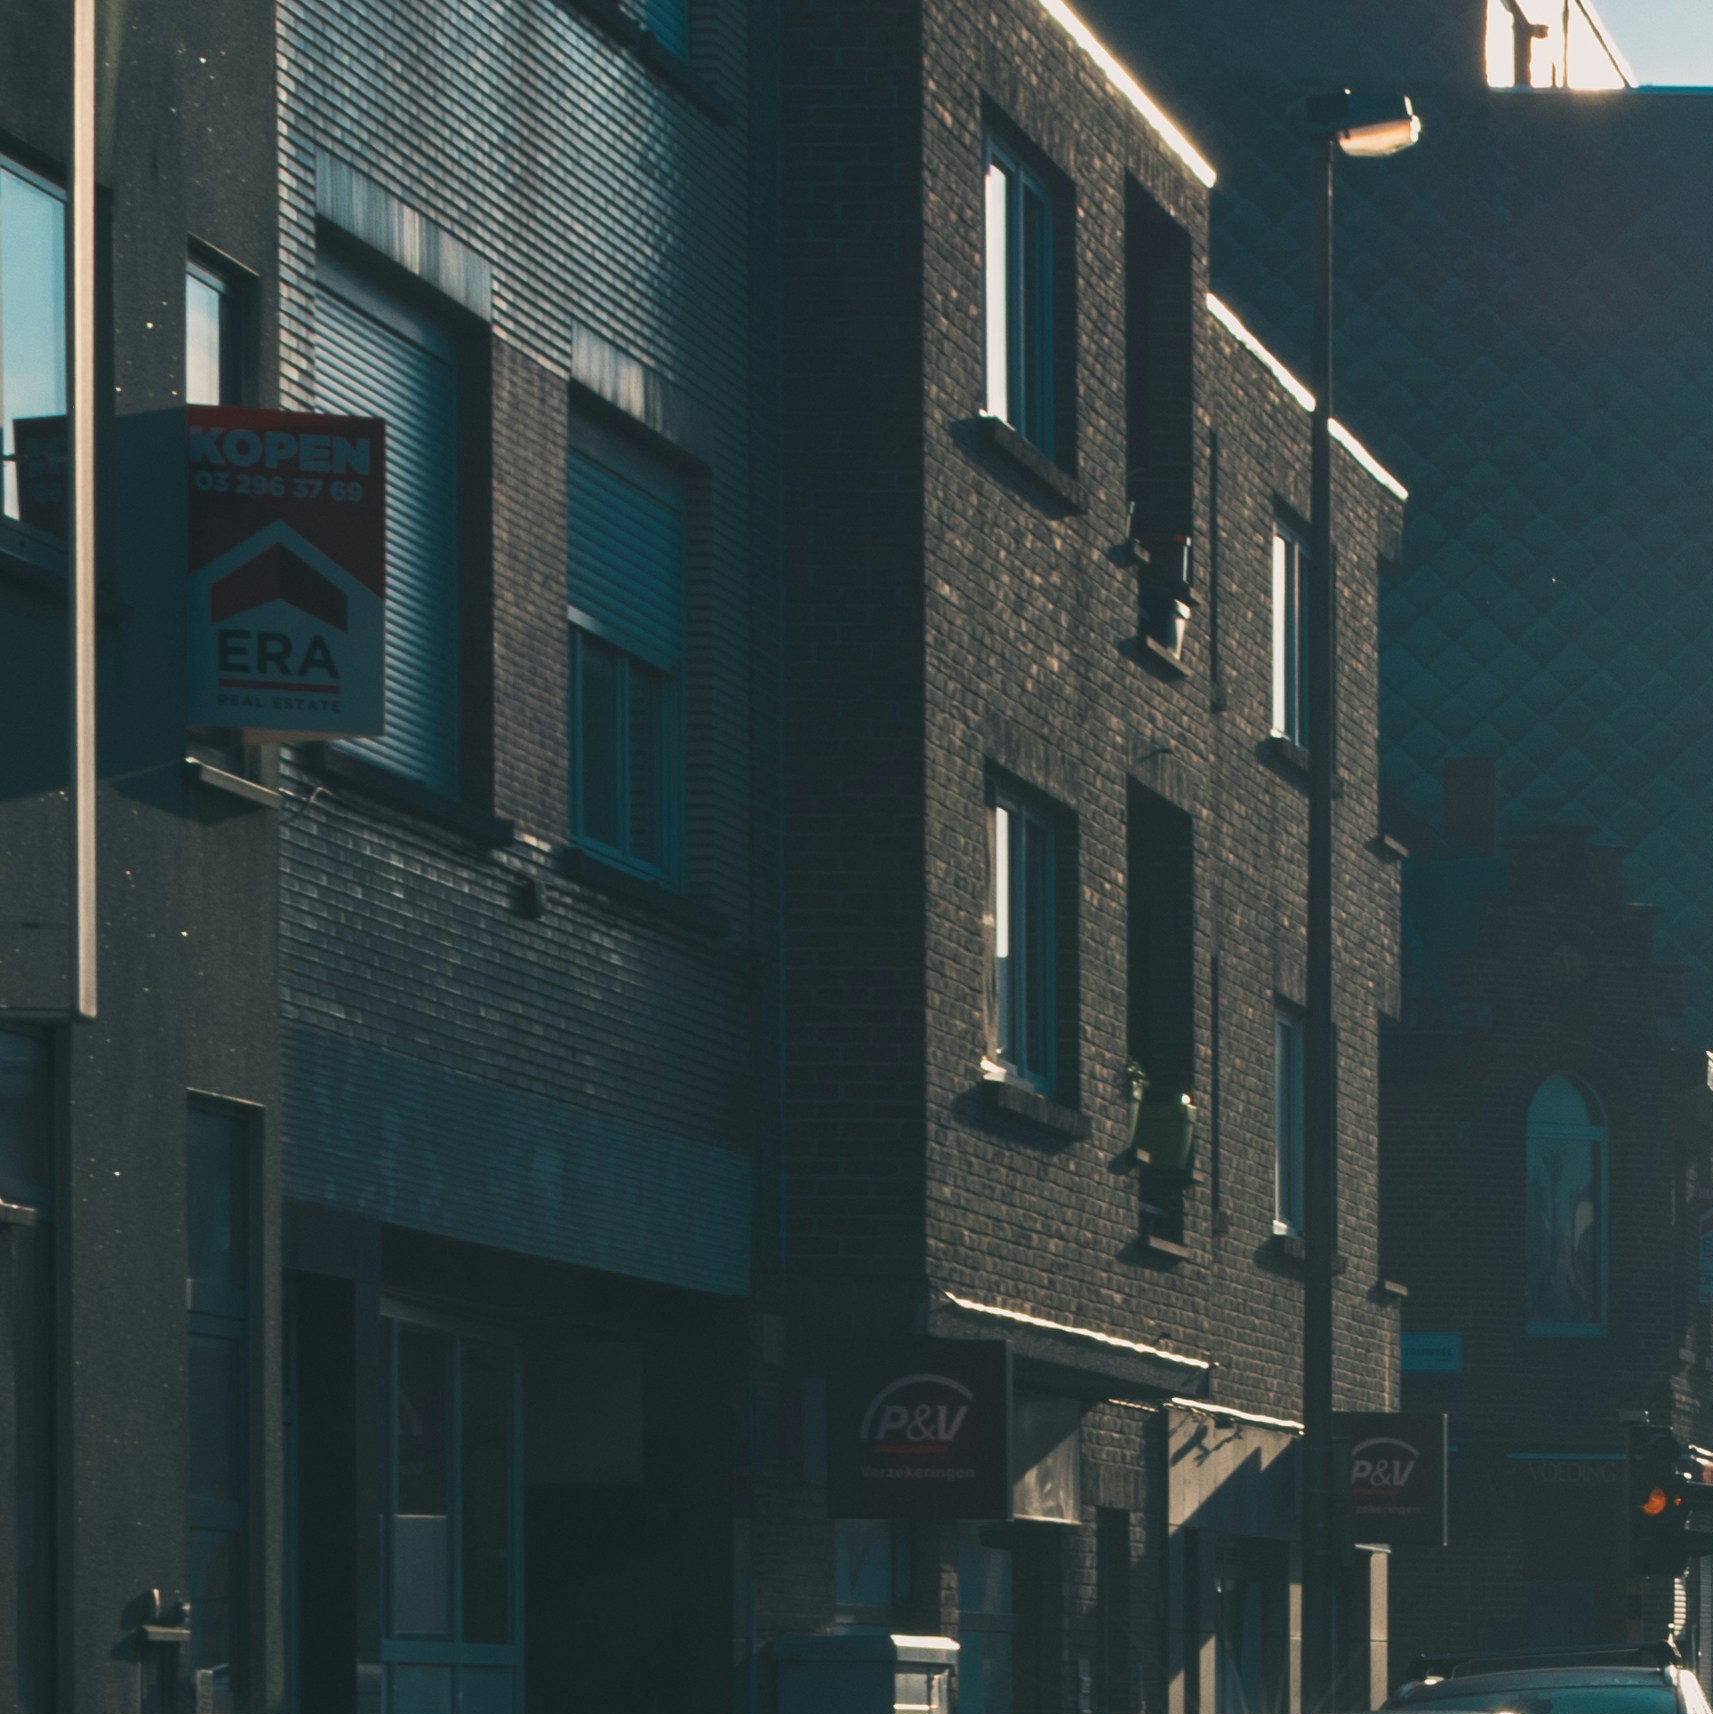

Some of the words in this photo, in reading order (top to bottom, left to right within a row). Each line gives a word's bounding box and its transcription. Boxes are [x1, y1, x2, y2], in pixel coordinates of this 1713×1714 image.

[188, 427, 371, 476] KOPEN
[196, 472, 231, 496] 03
[235, 473, 285, 498] 296
[293, 477, 326, 500] 37
[330, 480, 364, 503] 69
[218, 629, 340, 679] ERA
[217, 692, 265, 710] REAL
[272, 696, 342, 715] ESTATE
[875, 1404, 969, 1441] P&V
[861, 1464, 976, 1482] Verzekeringen
[1351, 1459, 1416, 1487] P&V
